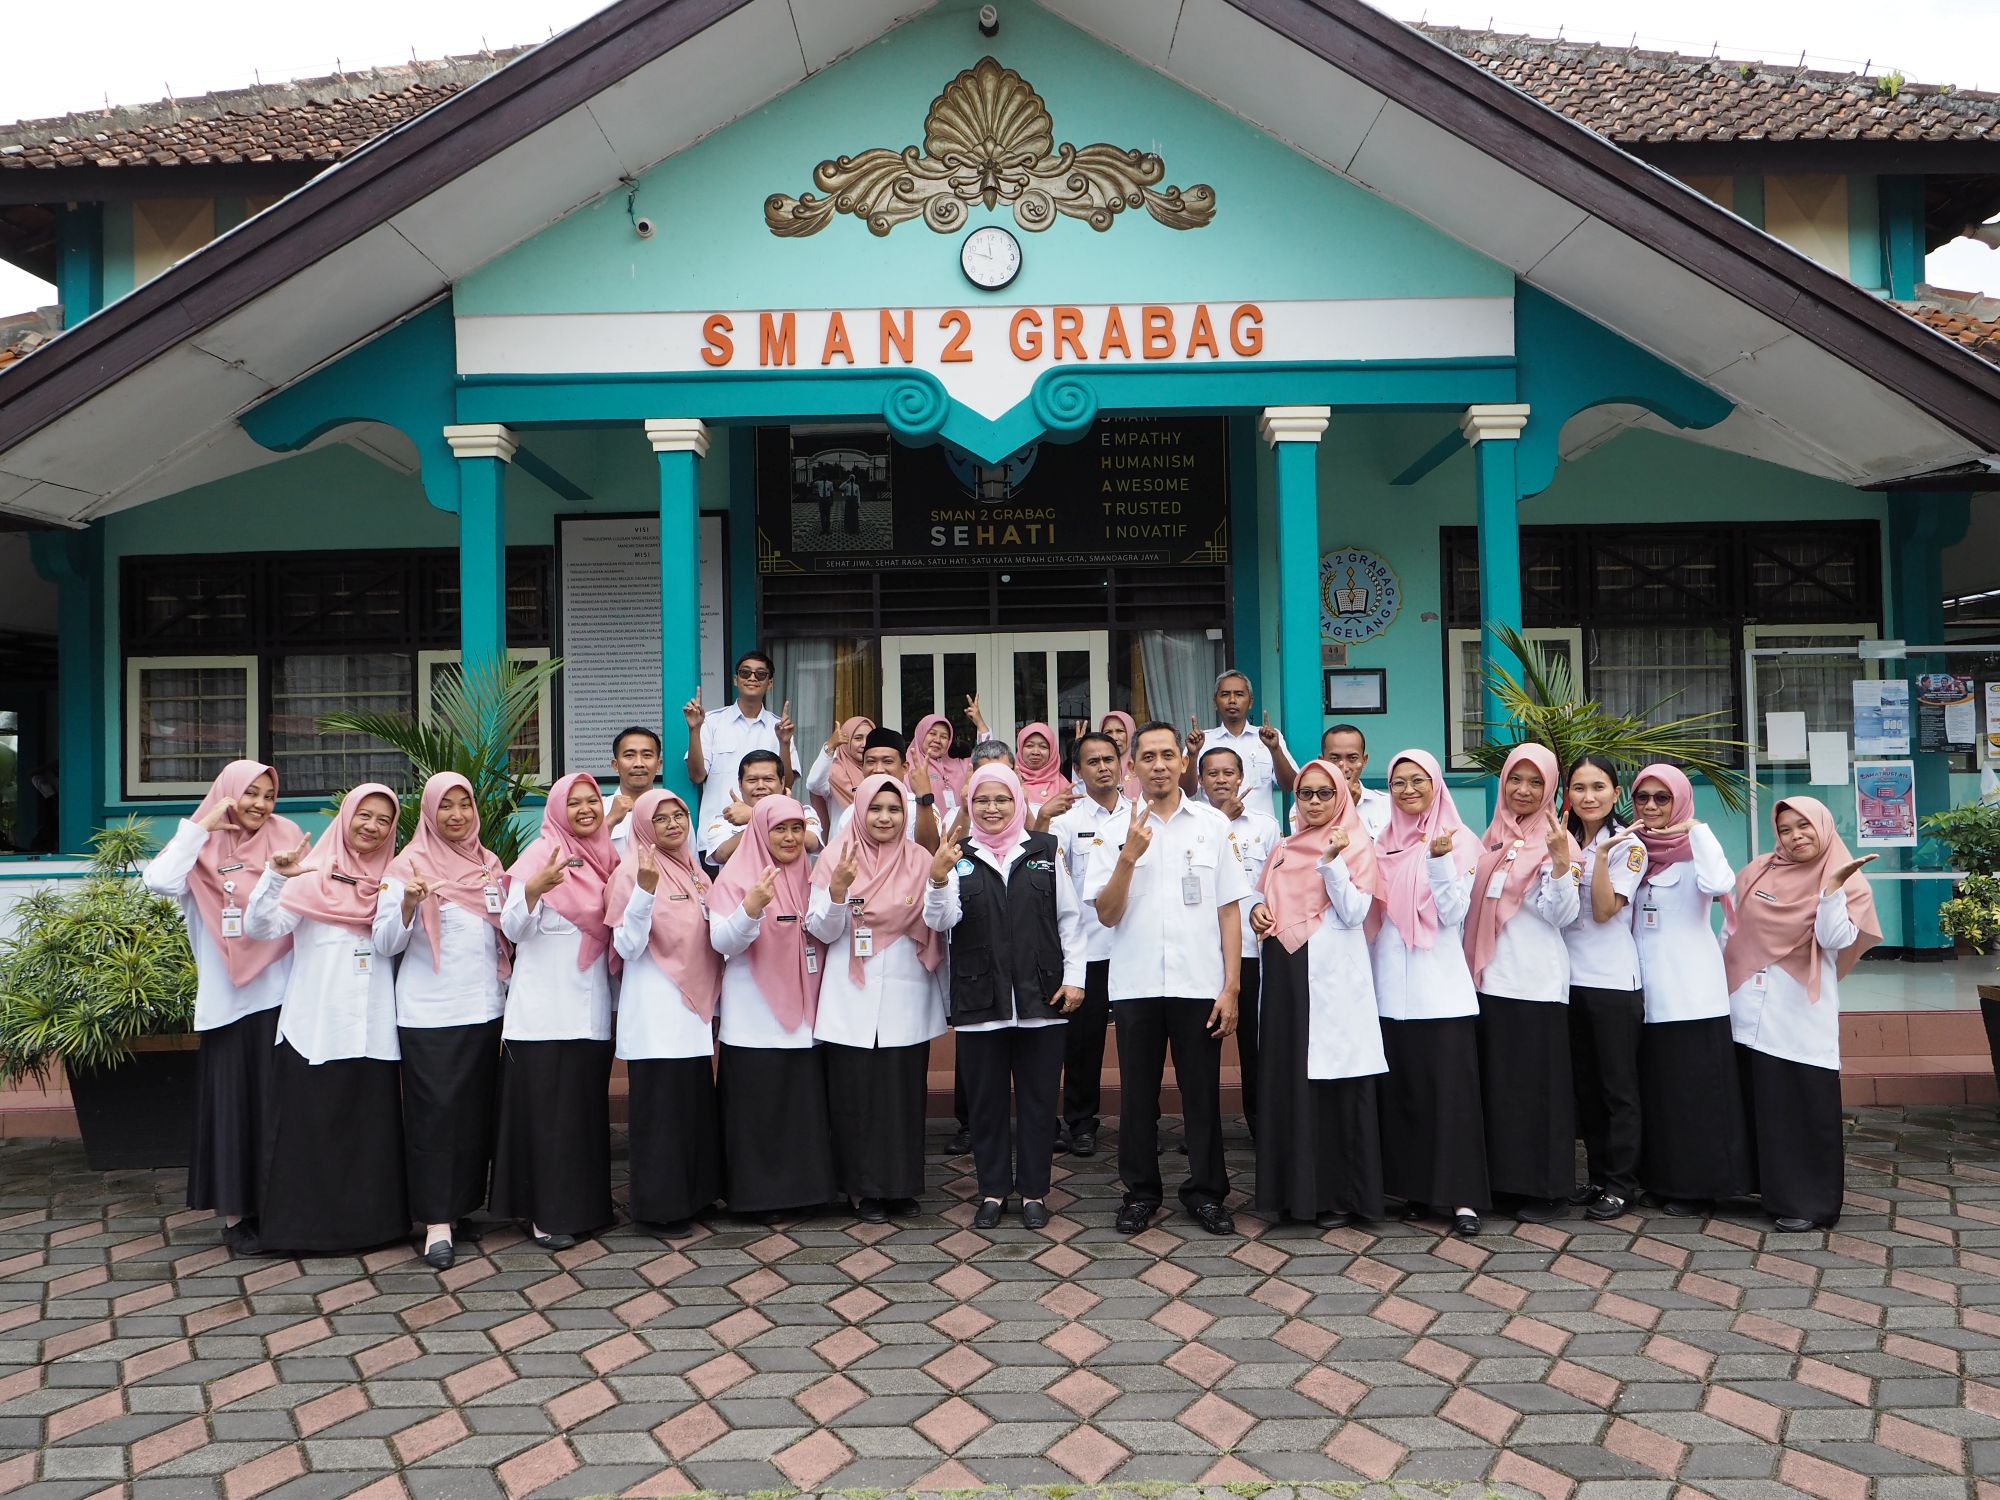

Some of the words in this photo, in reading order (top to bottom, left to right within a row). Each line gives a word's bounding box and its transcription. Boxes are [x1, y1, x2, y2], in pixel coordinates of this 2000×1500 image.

[700, 309, 914, 367] SMAN
[939, 310, 973, 363] 2
[1008, 304, 1264, 361] GRABAG
[930, 510, 976, 521] SMAN
[980, 510, 989, 520] 2
[992, 508, 1056, 520] GRABAG
[930, 524, 1055, 547] SEHATI
[826, 560, 851, 568] SEHAT
[875, 559, 901, 567] SEHAT
[927, 558, 948, 566] SATU
[971, 557, 991, 565] SATU
[993, 556, 1013, 564] KATA
[1015, 556, 1045, 564] MERAIH
[1089, 554, 1139, 563] SMANDAGRA
[1141, 553, 1160, 562] JAYA
[1336, 555, 1343, 564] 2
[1349, 553, 1395, 597] GRABAG
